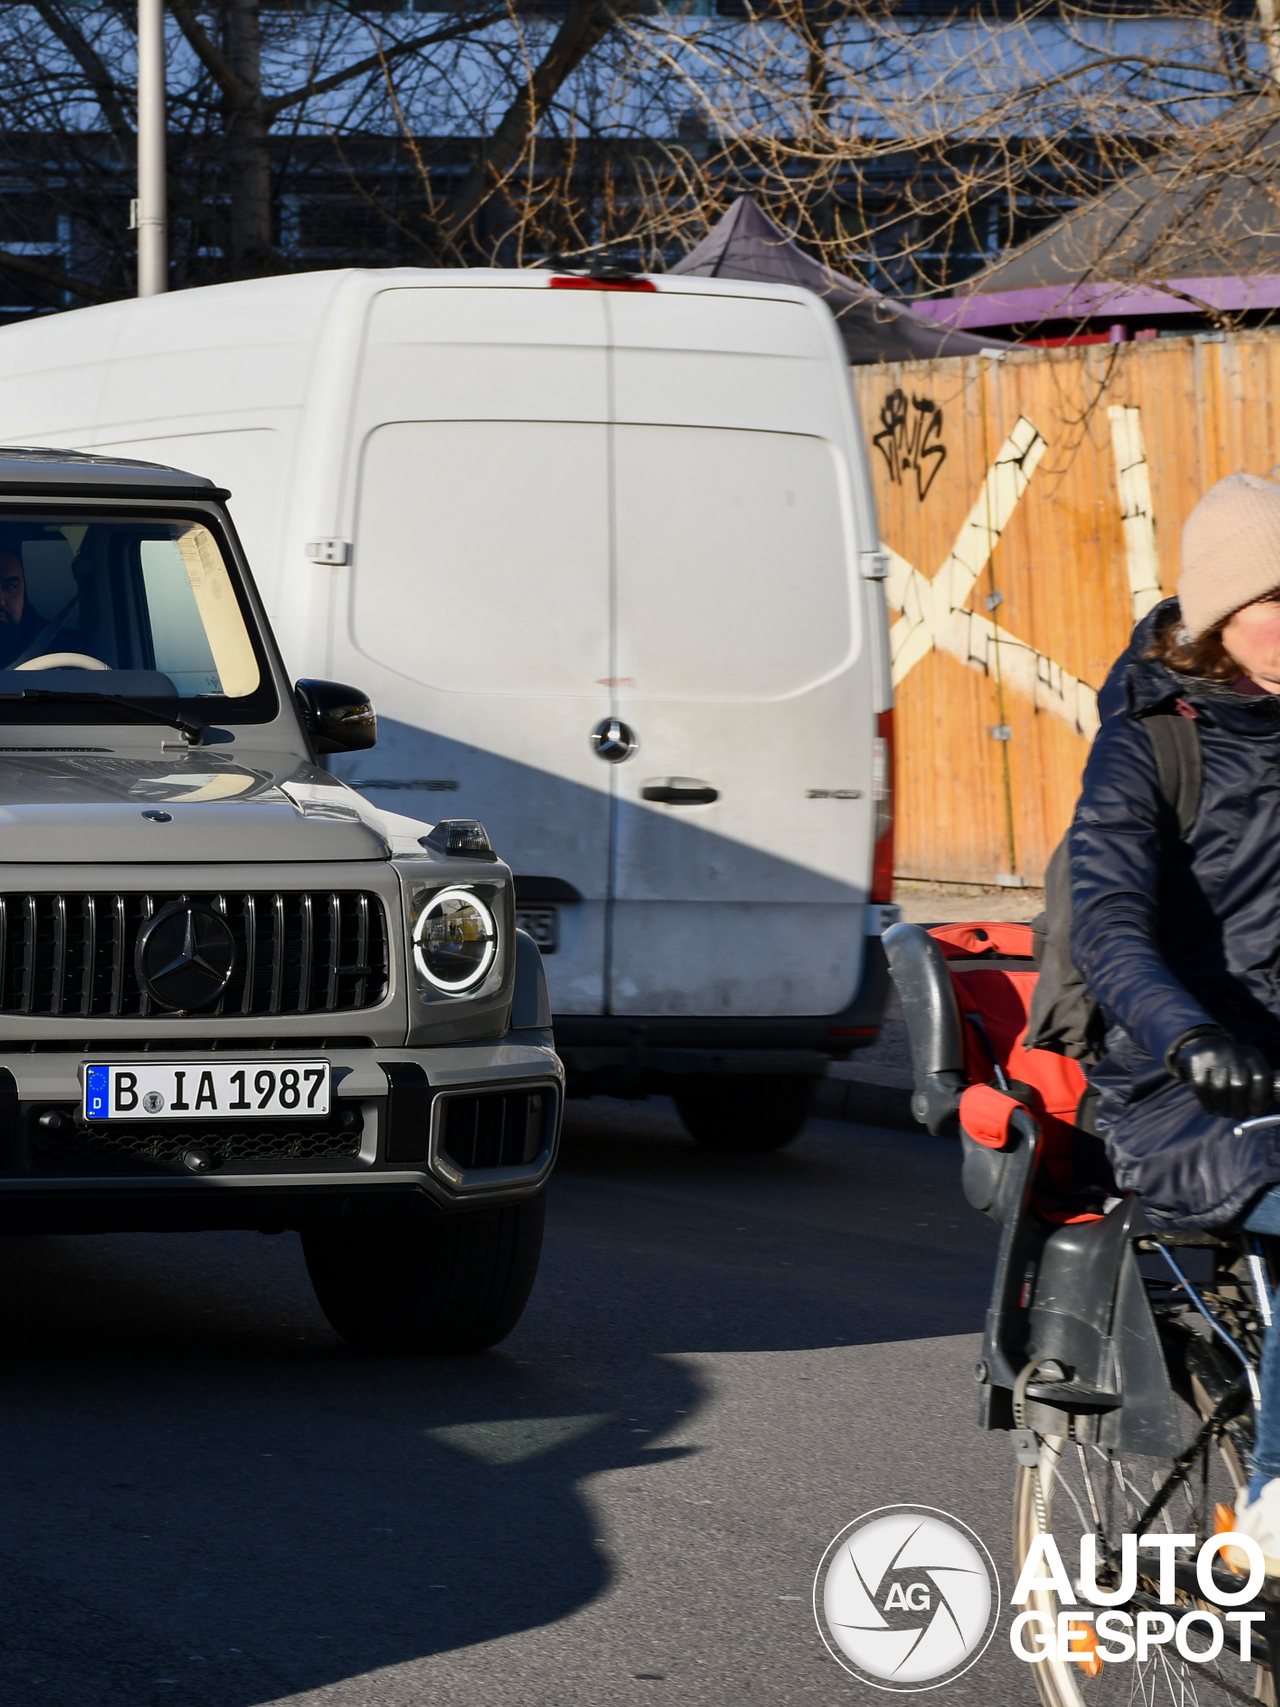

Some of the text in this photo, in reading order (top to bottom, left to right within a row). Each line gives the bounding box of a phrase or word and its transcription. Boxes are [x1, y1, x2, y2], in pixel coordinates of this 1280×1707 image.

[93, 1069, 326, 1111] D B IA 1987
